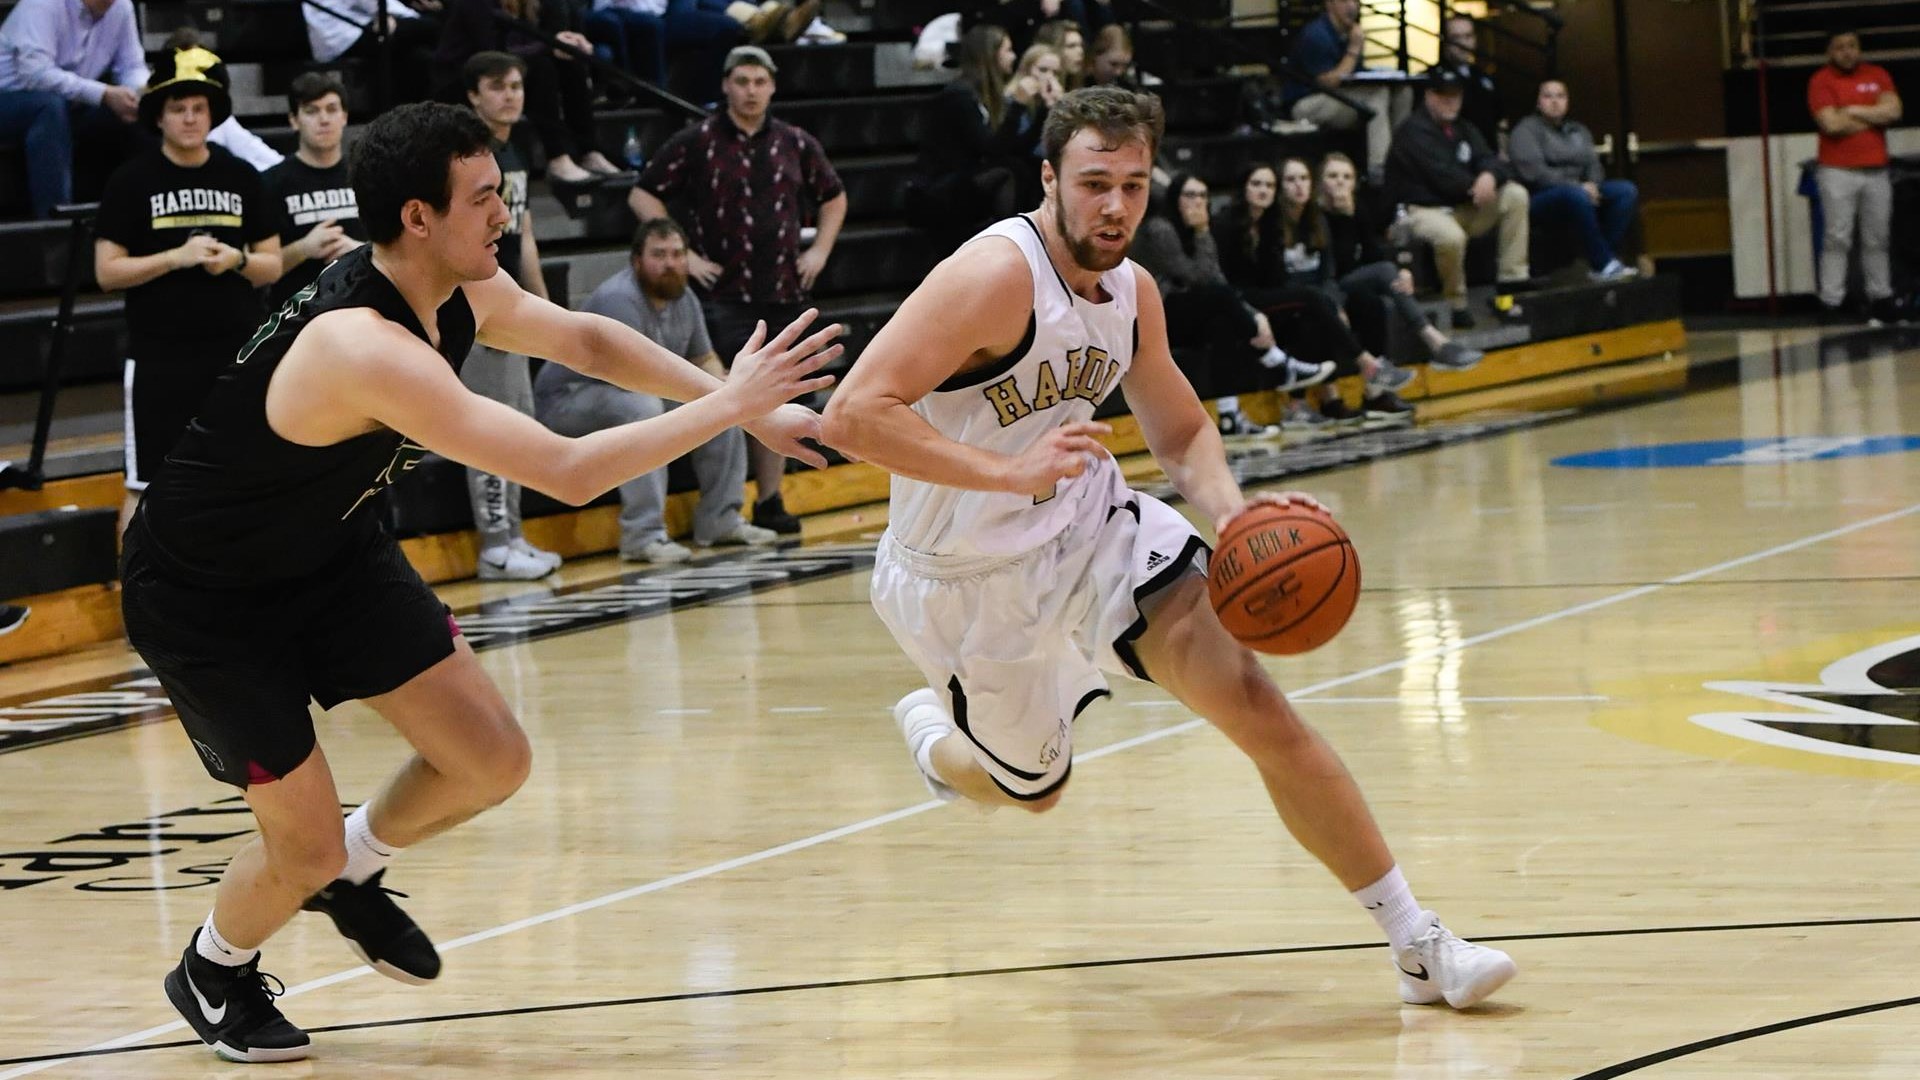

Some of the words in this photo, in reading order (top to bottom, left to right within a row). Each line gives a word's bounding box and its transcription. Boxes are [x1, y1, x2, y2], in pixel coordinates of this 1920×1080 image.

[150, 188, 243, 218] HARDING
[982, 345, 1121, 428] HARDI
[485, 476, 504, 525] RNIA
